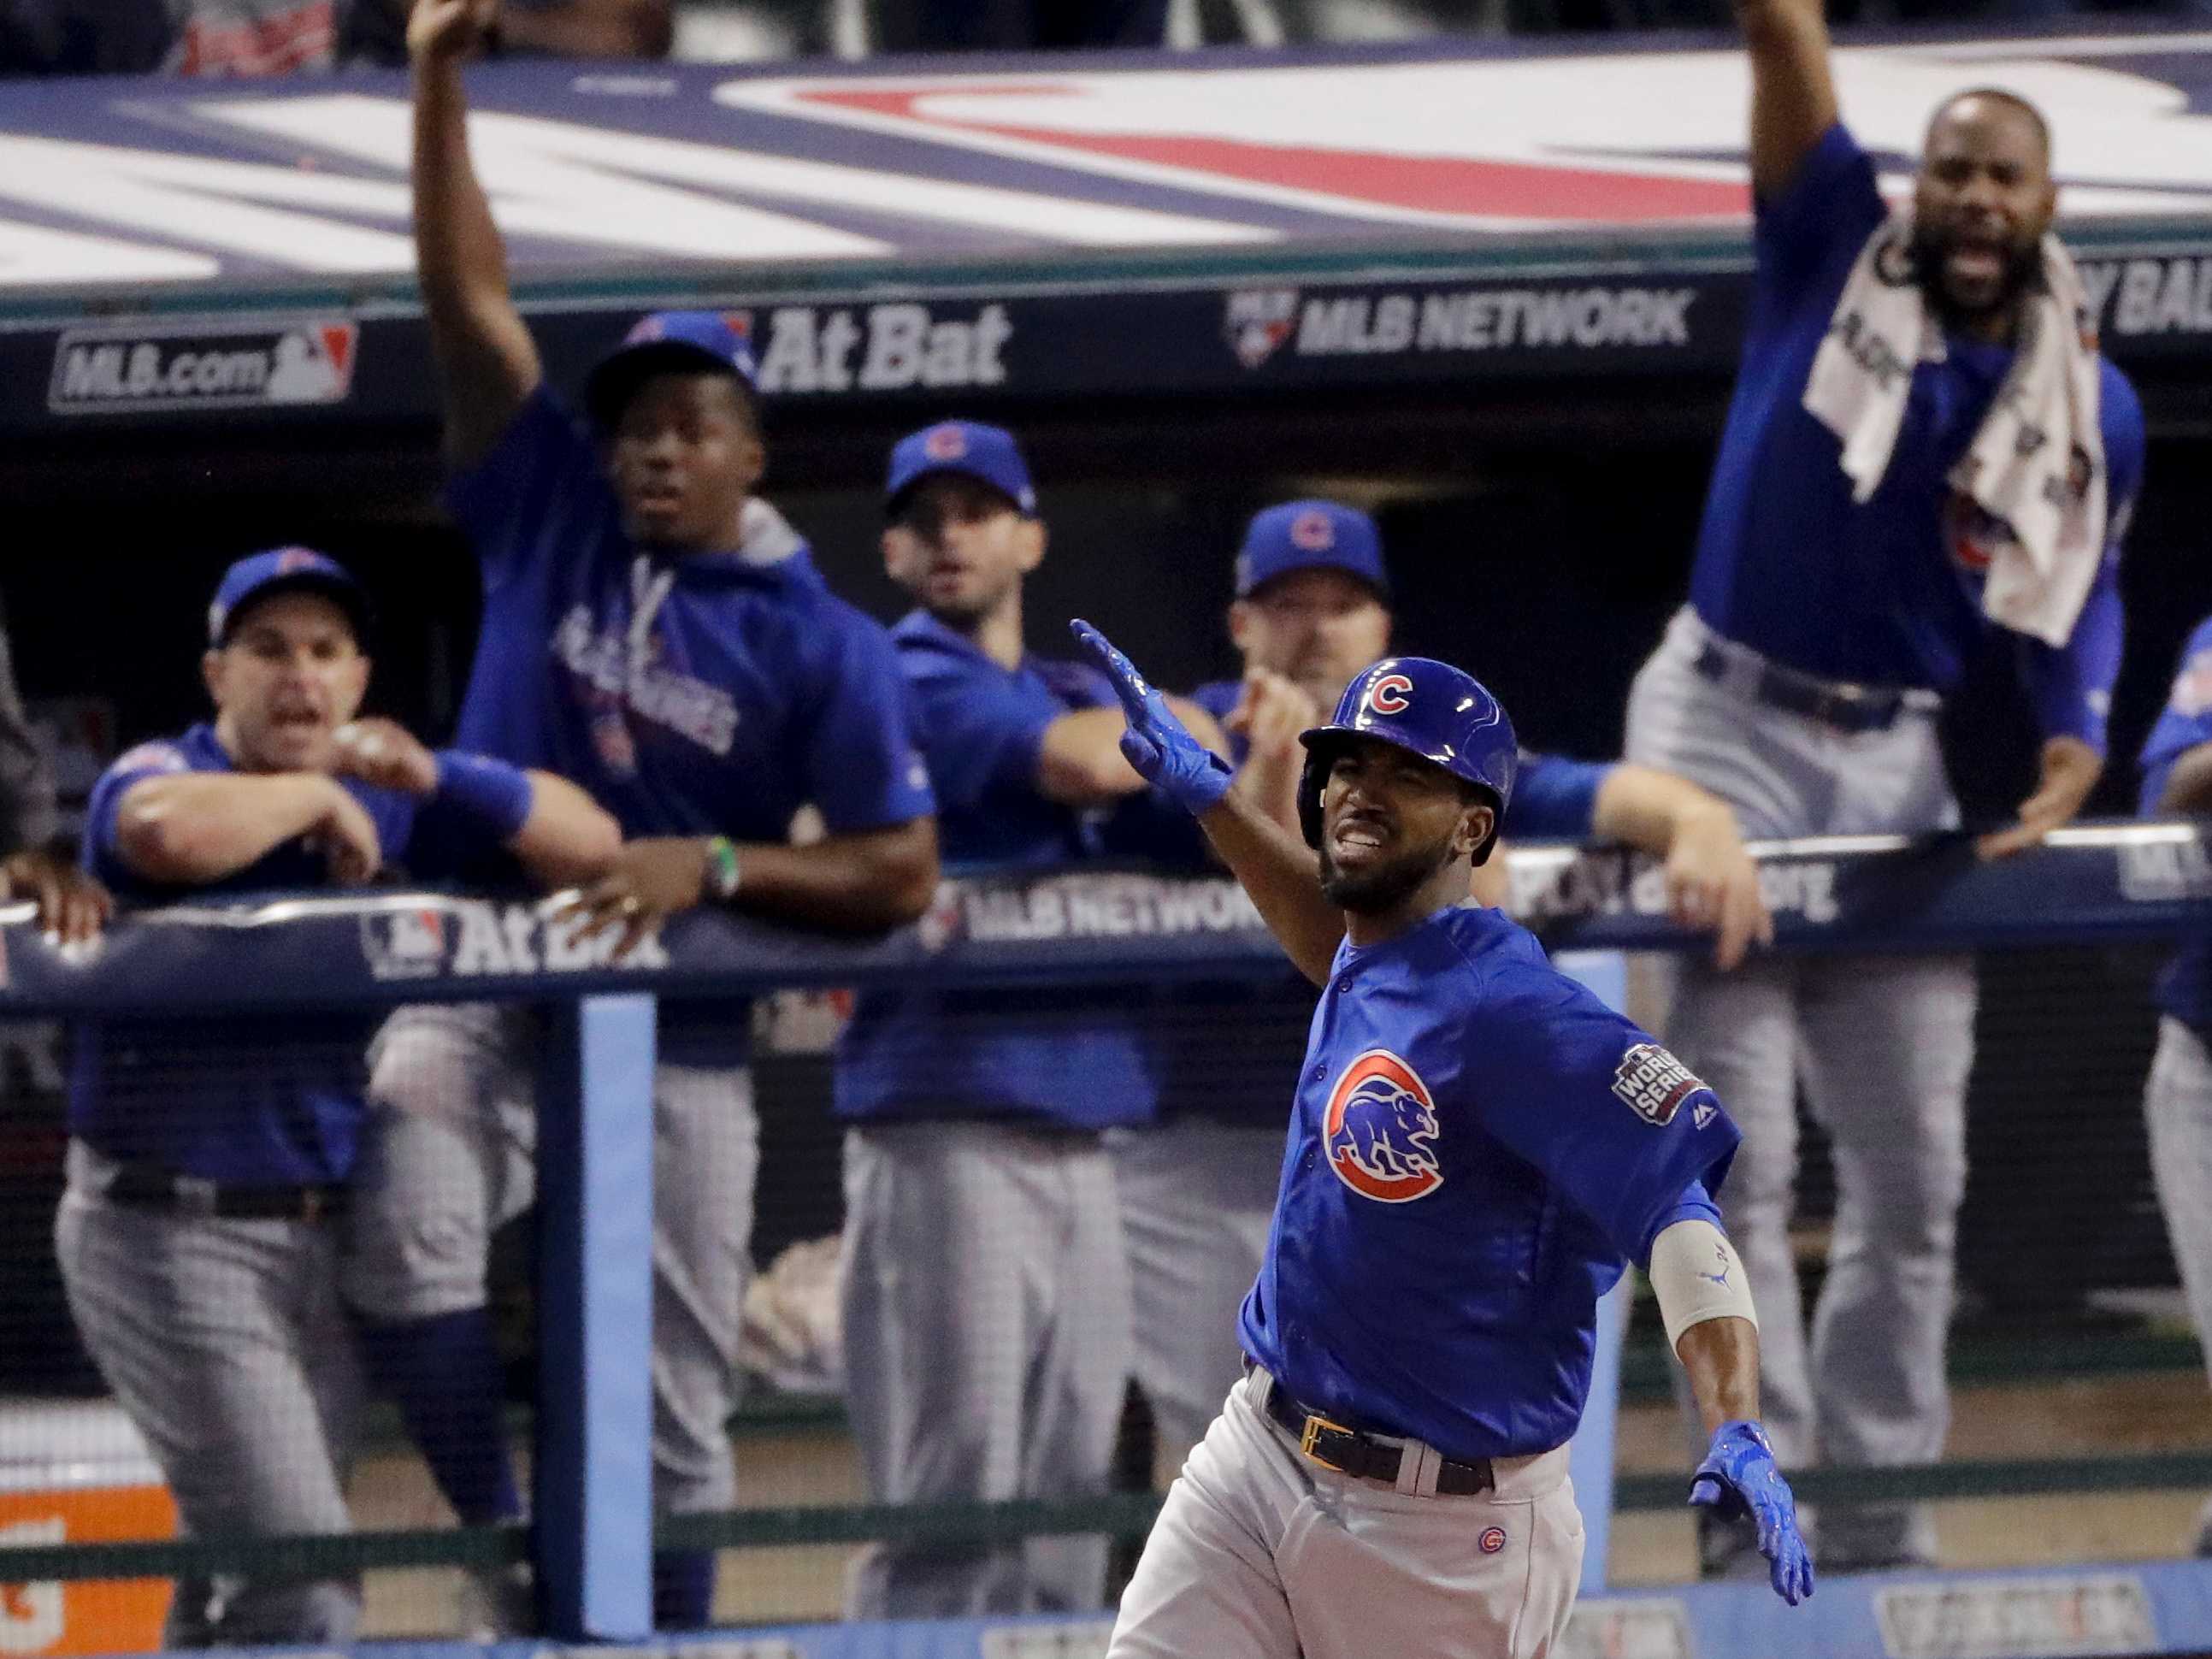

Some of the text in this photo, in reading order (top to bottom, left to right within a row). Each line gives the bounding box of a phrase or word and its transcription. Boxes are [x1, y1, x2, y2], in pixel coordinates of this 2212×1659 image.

[1295, 296, 1415, 355] MLB
[1417, 287, 1697, 350] NETWORK
[63, 343, 268, 396] MLB.com
[1370, 675, 1413, 715] C
